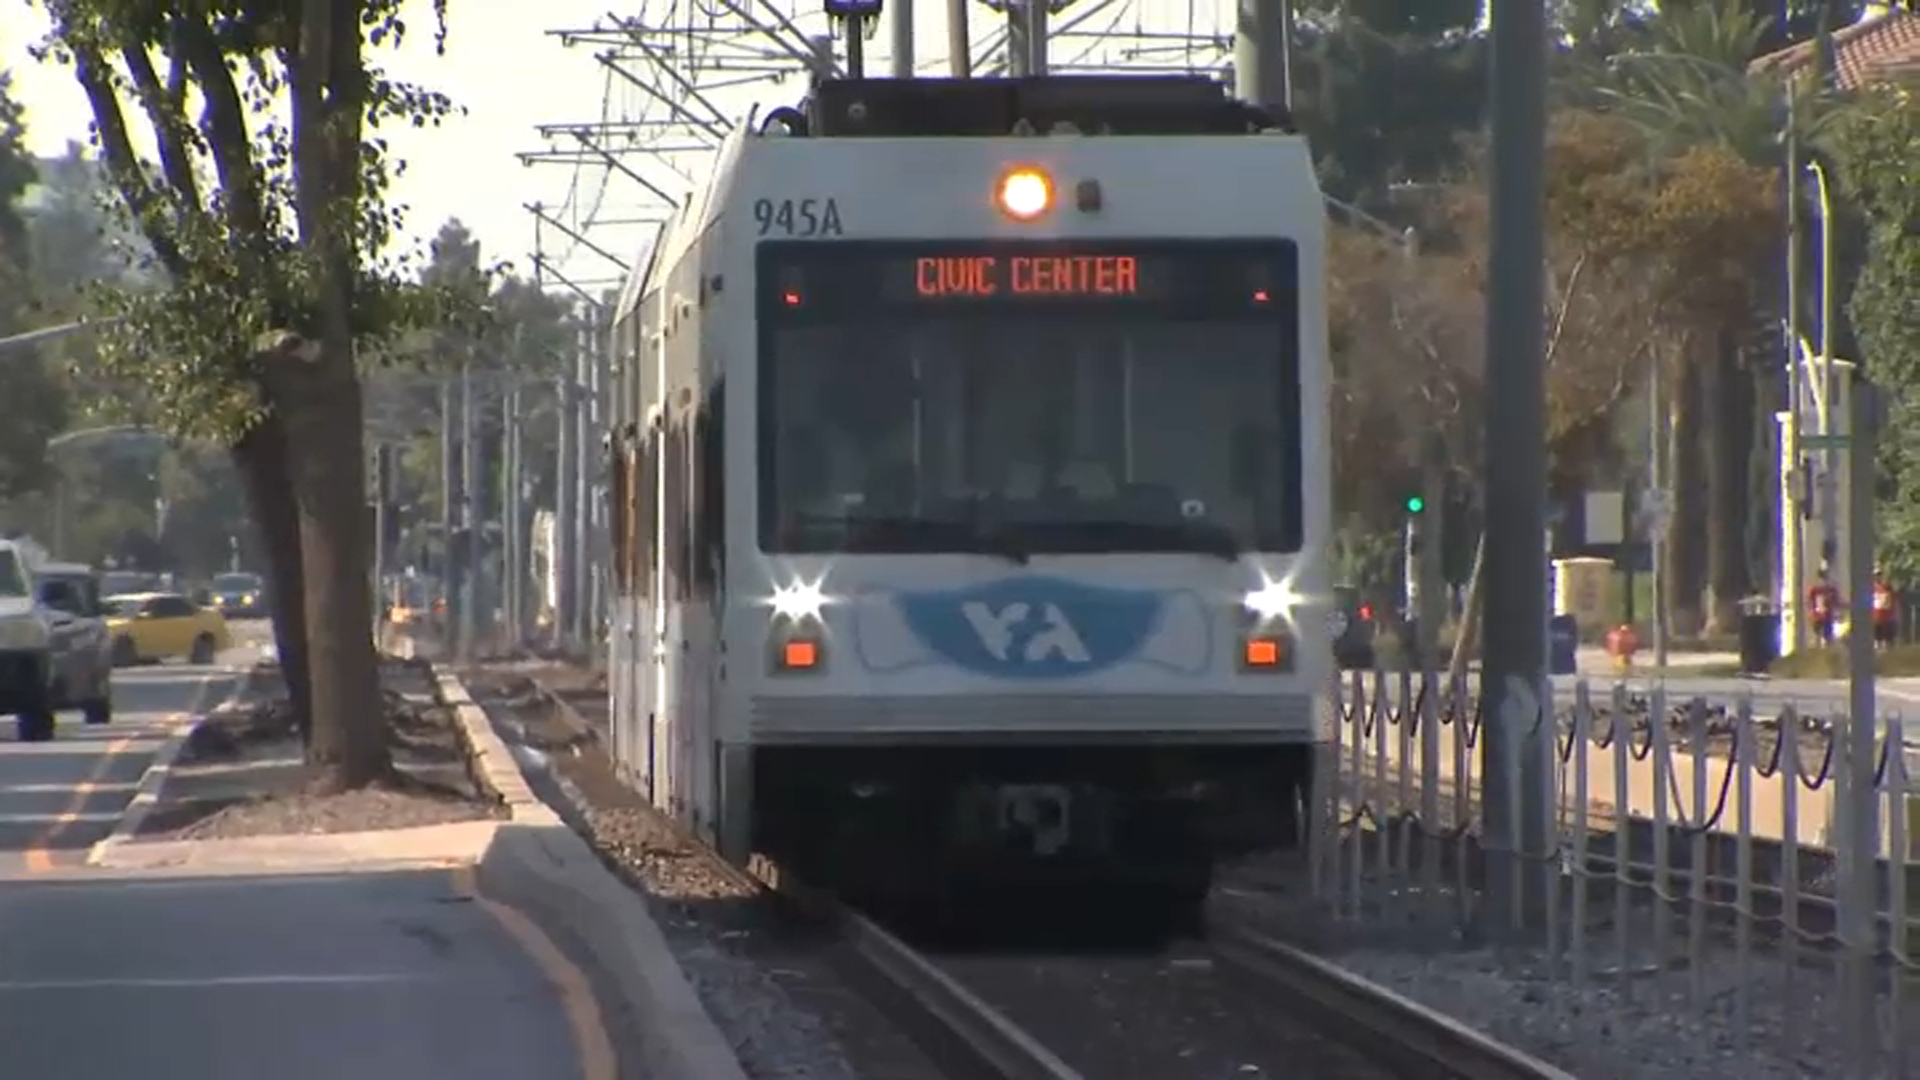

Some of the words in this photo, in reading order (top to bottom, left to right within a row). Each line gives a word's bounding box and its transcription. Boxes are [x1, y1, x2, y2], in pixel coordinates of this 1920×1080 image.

[754, 198, 843, 237] 945A
[916, 256, 996, 293] CIVIC
[1011, 256, 1137, 293] CENTER
